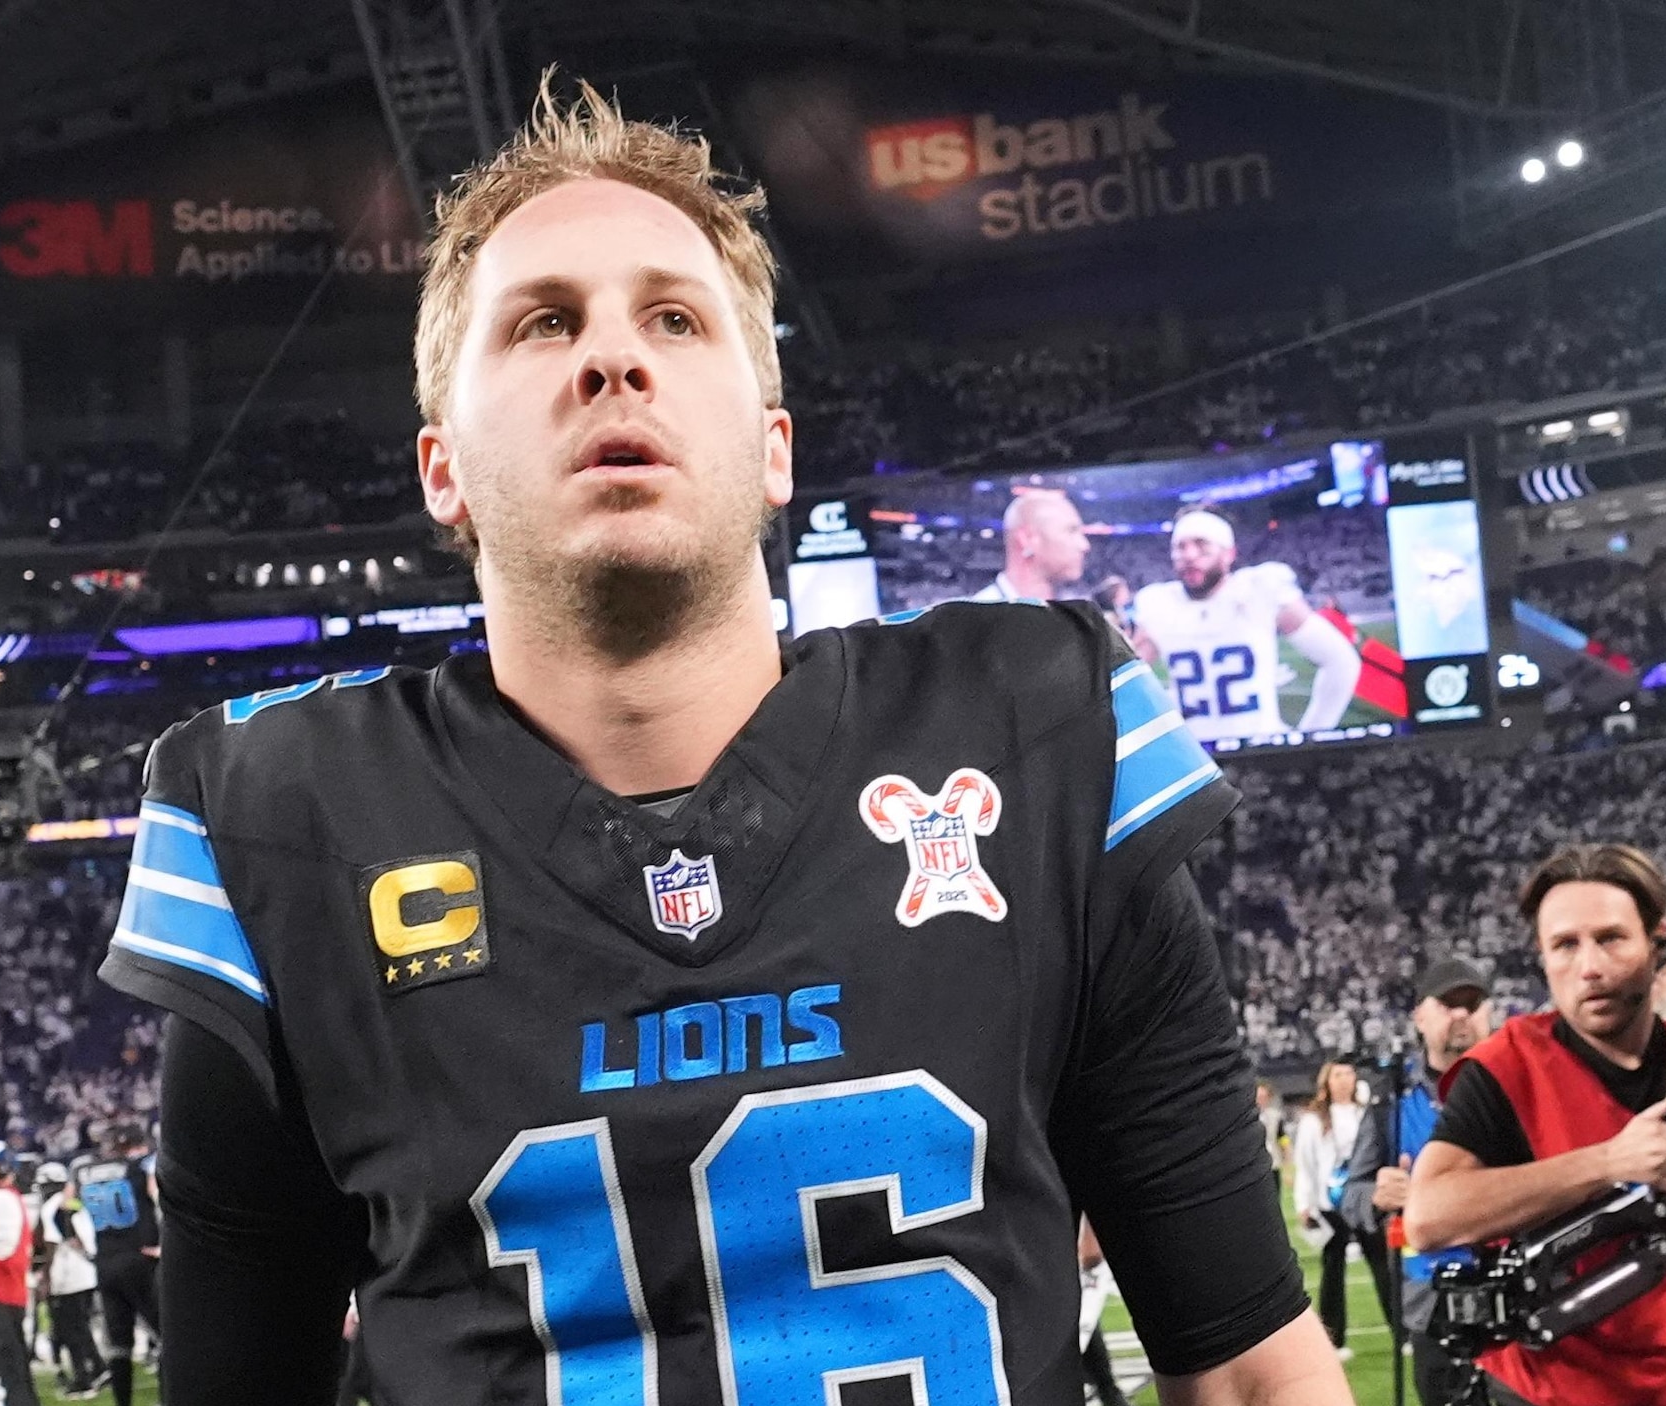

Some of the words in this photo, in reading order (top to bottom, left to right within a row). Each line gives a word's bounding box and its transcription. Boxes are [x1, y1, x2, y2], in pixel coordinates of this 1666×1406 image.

[977, 152, 1272, 240] stadium
[1167, 644, 1260, 719] 22
[920, 840, 967, 873] NFL
[369, 861, 481, 958] C
[661, 890, 710, 925] NFL
[580, 984, 844, 1092] LIONS
